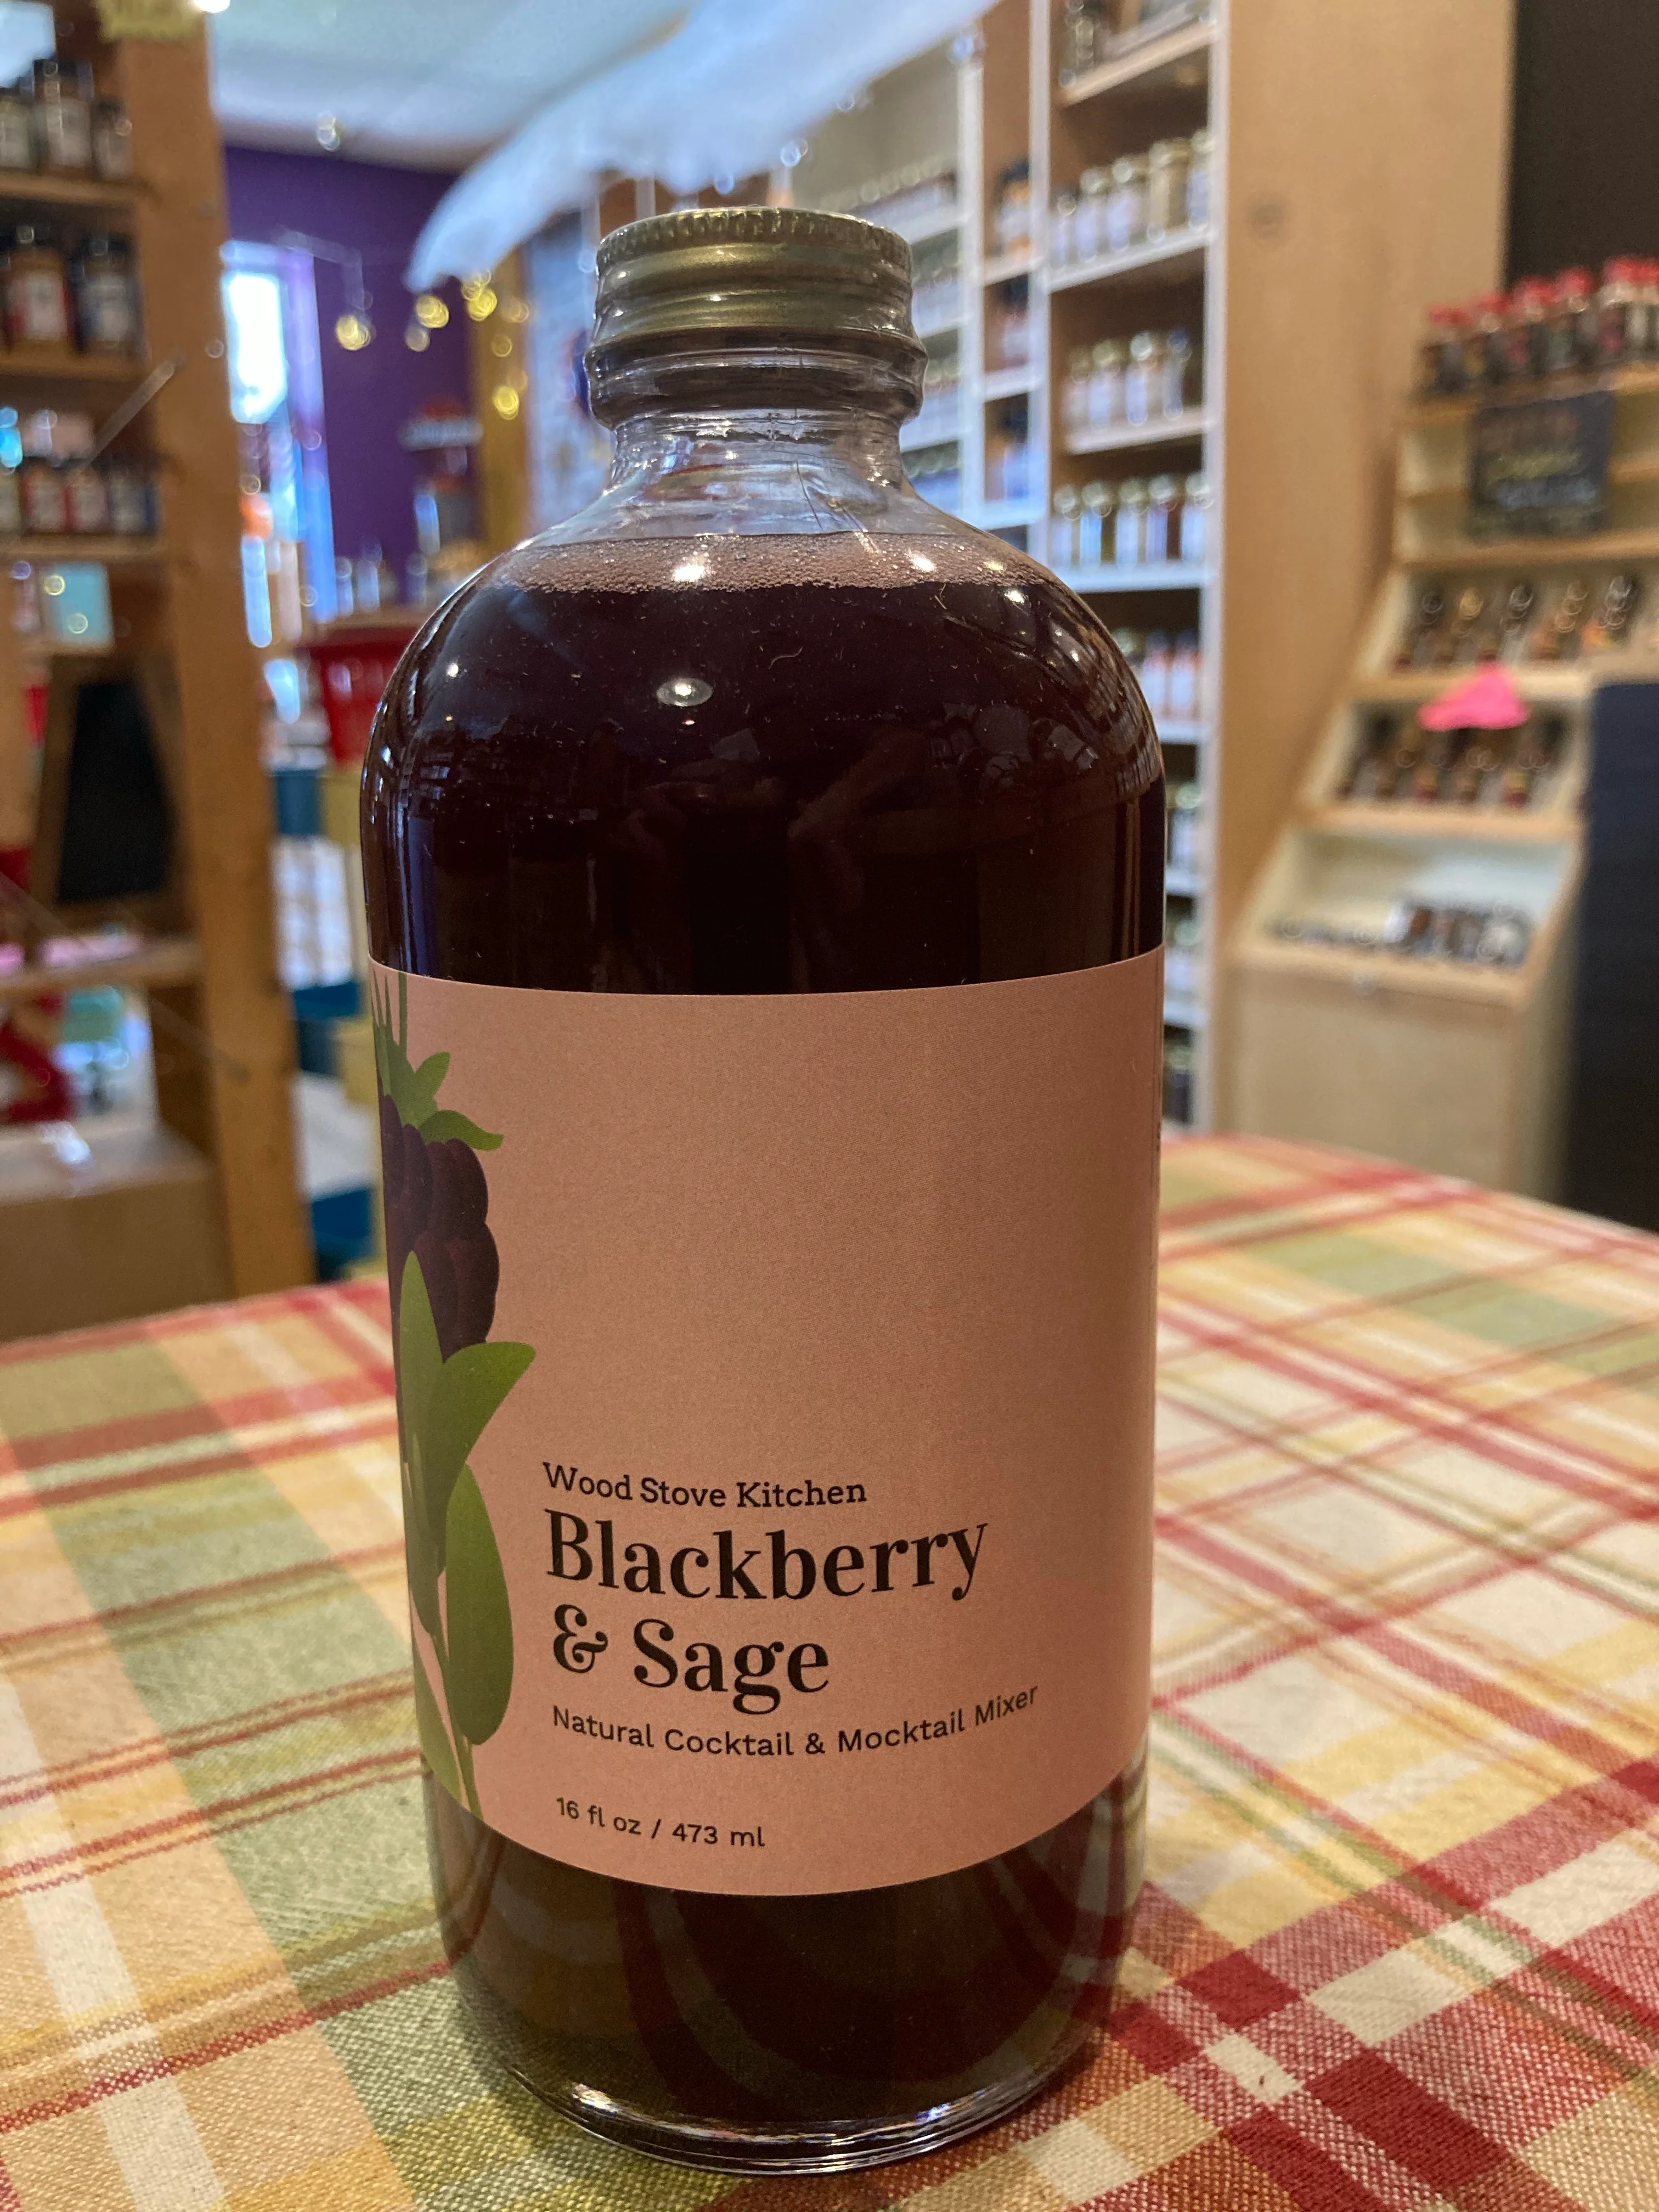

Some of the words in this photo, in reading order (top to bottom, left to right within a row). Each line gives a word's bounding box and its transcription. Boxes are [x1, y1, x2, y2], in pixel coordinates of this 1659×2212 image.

[541, 1460, 634, 1502] Wood
[639, 1476, 727, 1509] Stove
[735, 1477, 868, 1509] Kitchen
[543, 1508, 989, 1602] Blackberry
[552, 1602, 609, 1675] &
[632, 1617, 830, 1716] Sage
[552, 1704, 655, 1749] Natural
[664, 1728, 795, 1757] Cocktail
[804, 1731, 827, 1756] &
[837, 1707, 967, 1753] Mocktail
[974, 1685, 1039, 1728] Mixer
[555, 1796, 580, 1821] 16
[586, 1803, 606, 1829] fl
[612, 1816, 642, 1837] oz
[650, 1817, 663, 1841] /
[671, 1821, 719, 1846] 473
[730, 1825, 767, 1848] ml
